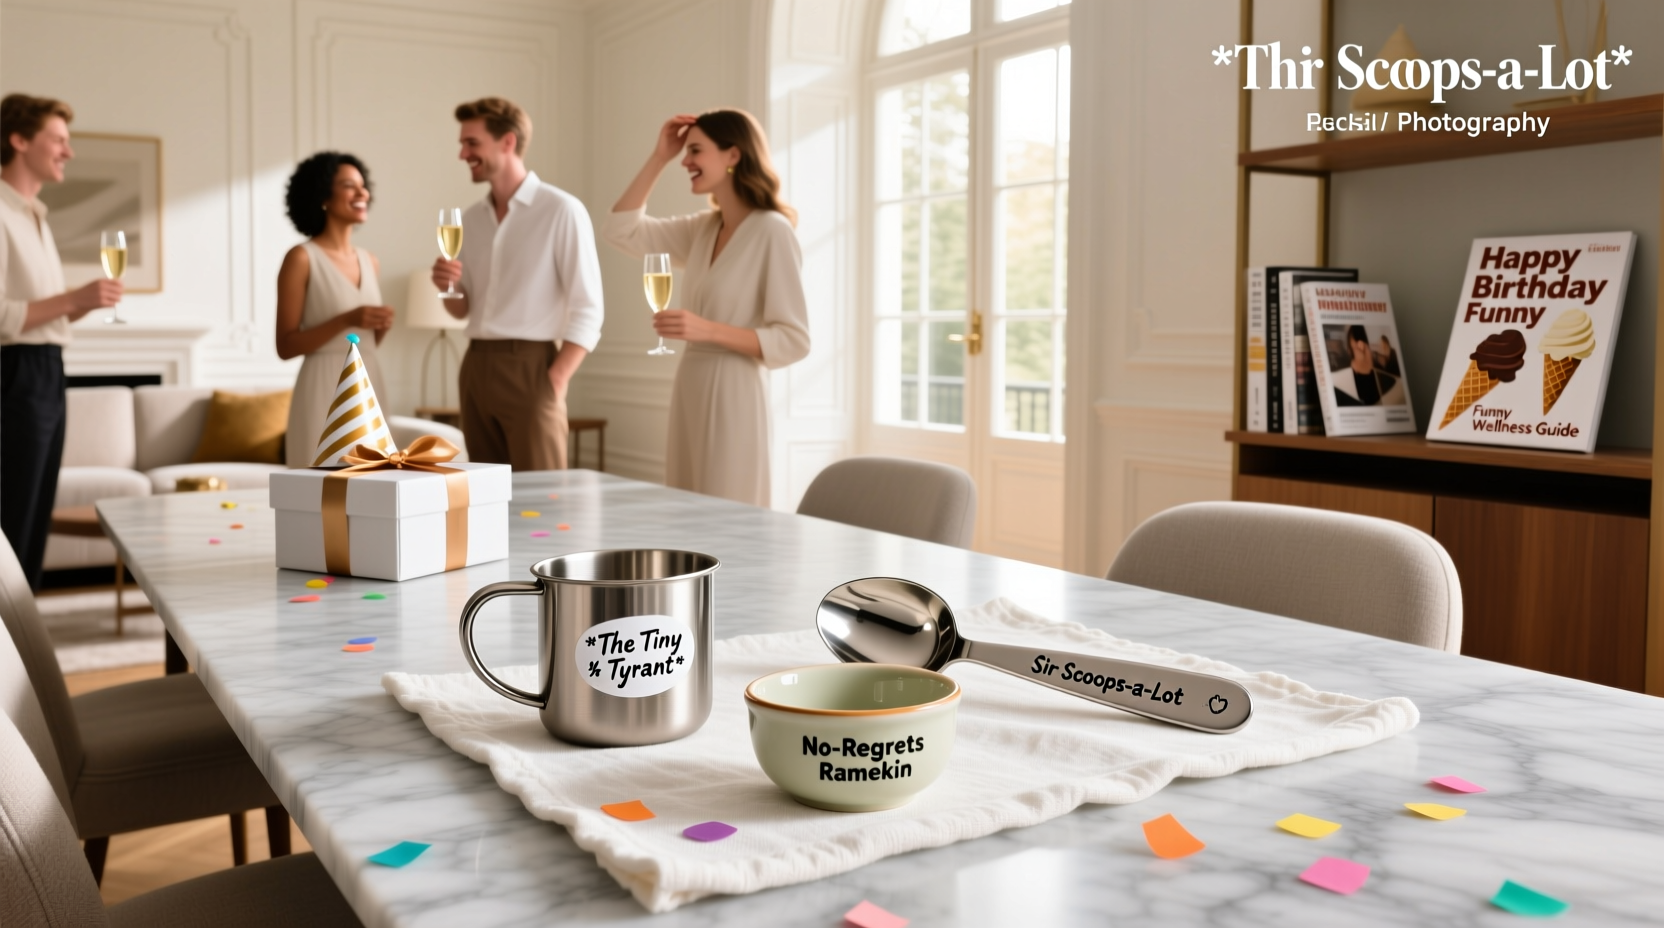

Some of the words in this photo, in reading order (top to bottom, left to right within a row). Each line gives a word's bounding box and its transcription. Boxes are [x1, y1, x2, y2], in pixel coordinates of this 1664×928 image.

[1480, 246, 1582, 275] Happy
[1471, 274, 1608, 306] Birthday
[1464, 302, 1547, 329] Funny
[1473, 404, 1512, 420] Funny
[1472, 419, 1532, 435] Wellness
[1535, 421, 1580, 437] Guide
[640, 628, 682, 656] Tiny
[1031, 655, 1059, 676] Sir
[1061, 662, 1184, 706] Scoops-a-Lot
[802, 735, 924, 762] No-Regrets
[819, 759, 912, 782] Ramekin
